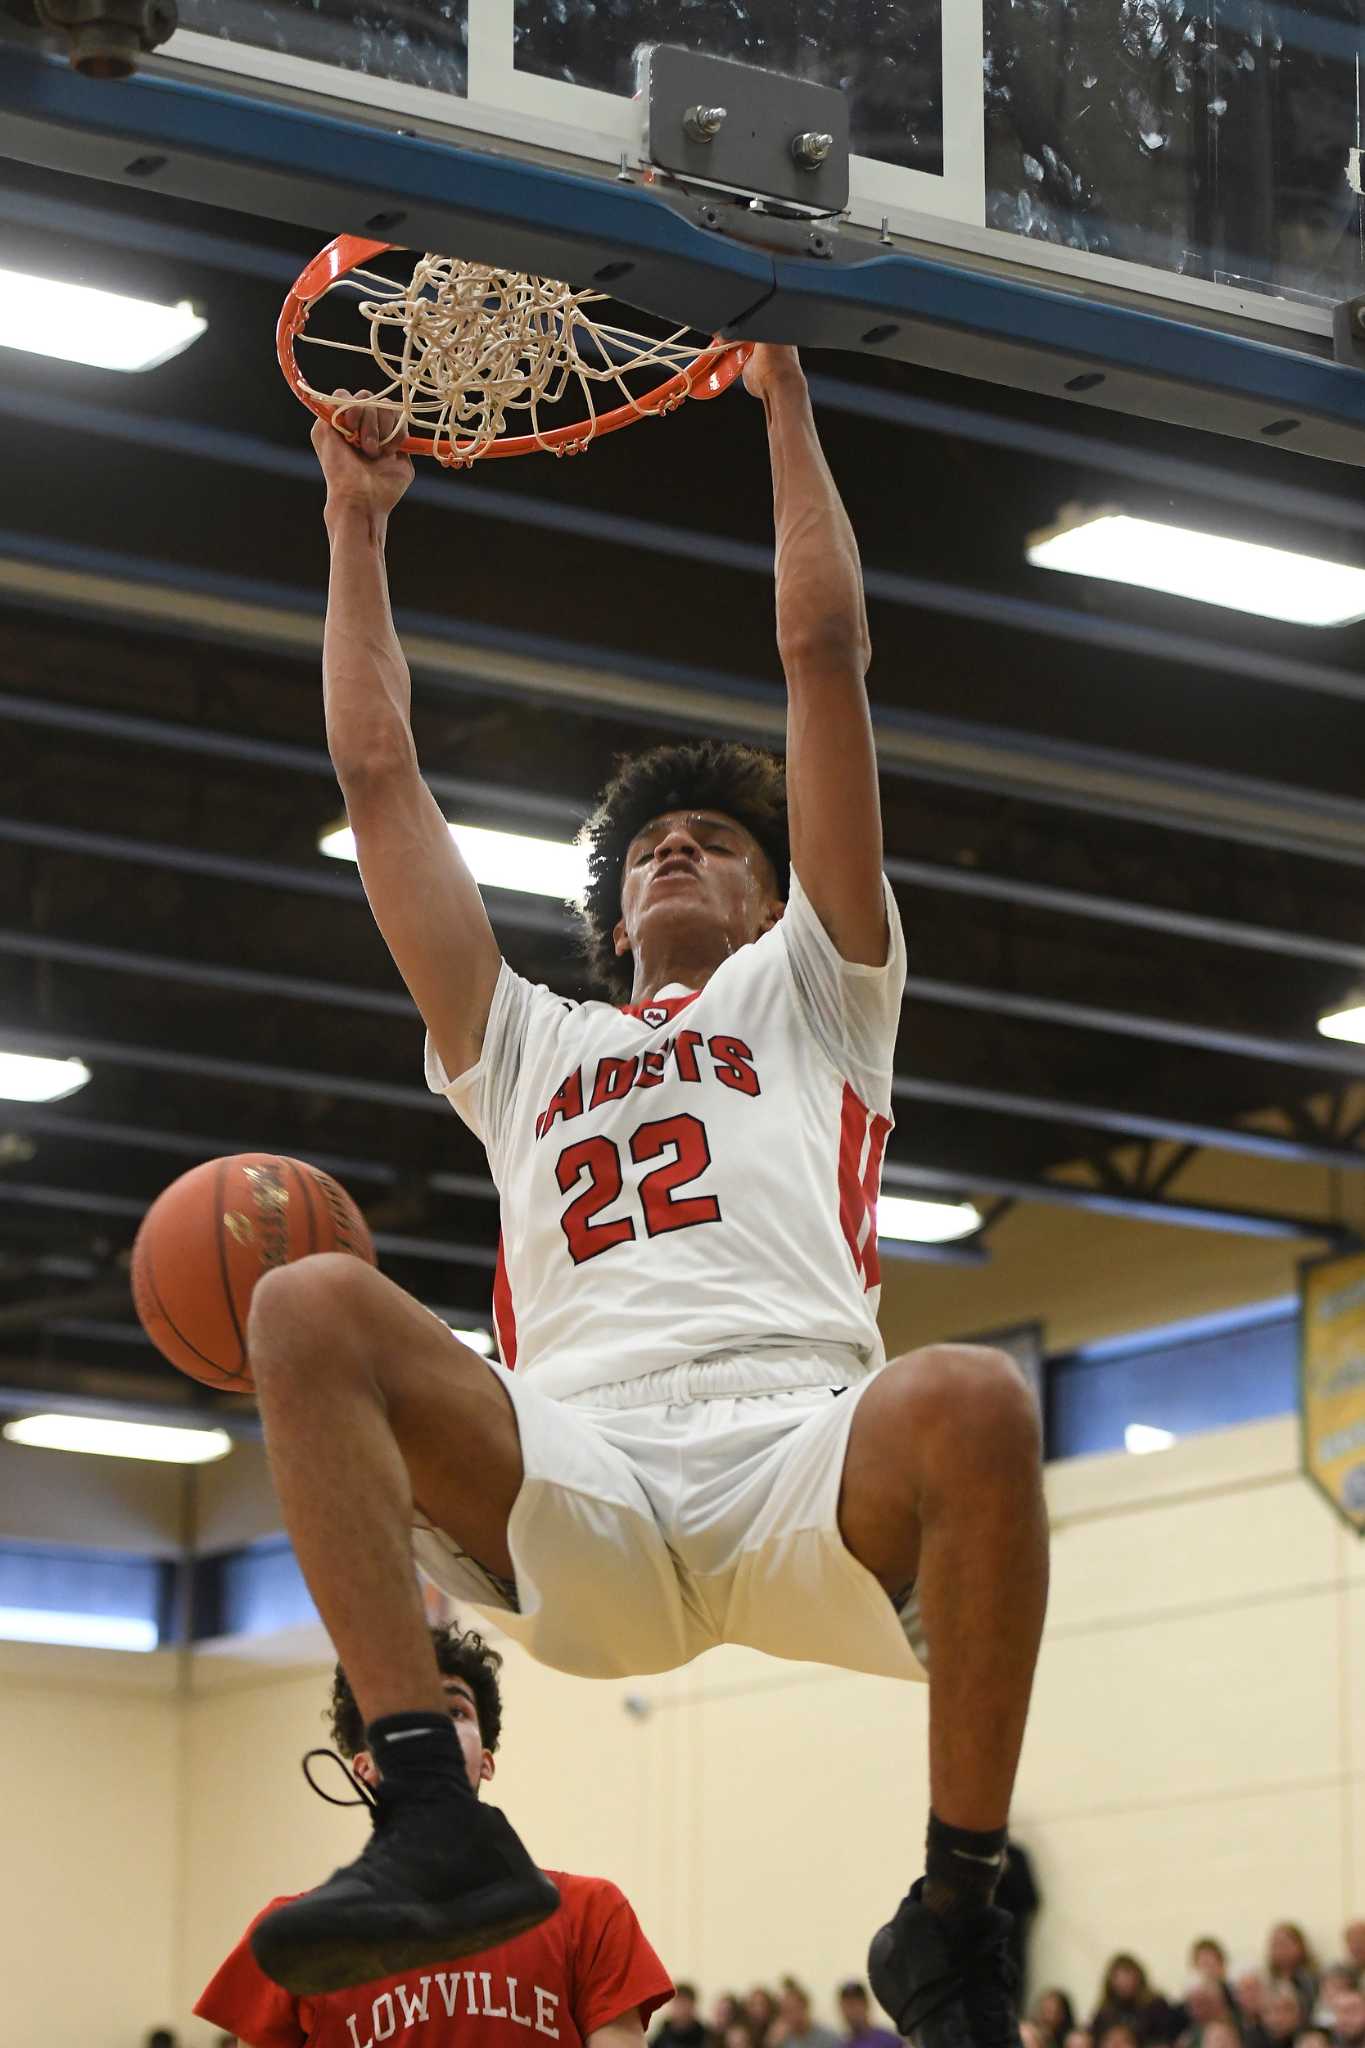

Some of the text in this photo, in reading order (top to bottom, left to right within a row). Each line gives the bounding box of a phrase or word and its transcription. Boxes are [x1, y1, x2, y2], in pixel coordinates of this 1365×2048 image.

[535, 1029, 762, 1142] ADETS
[554, 1112, 723, 1266] 22
[345, 1970, 560, 2048] LOWVILLE
